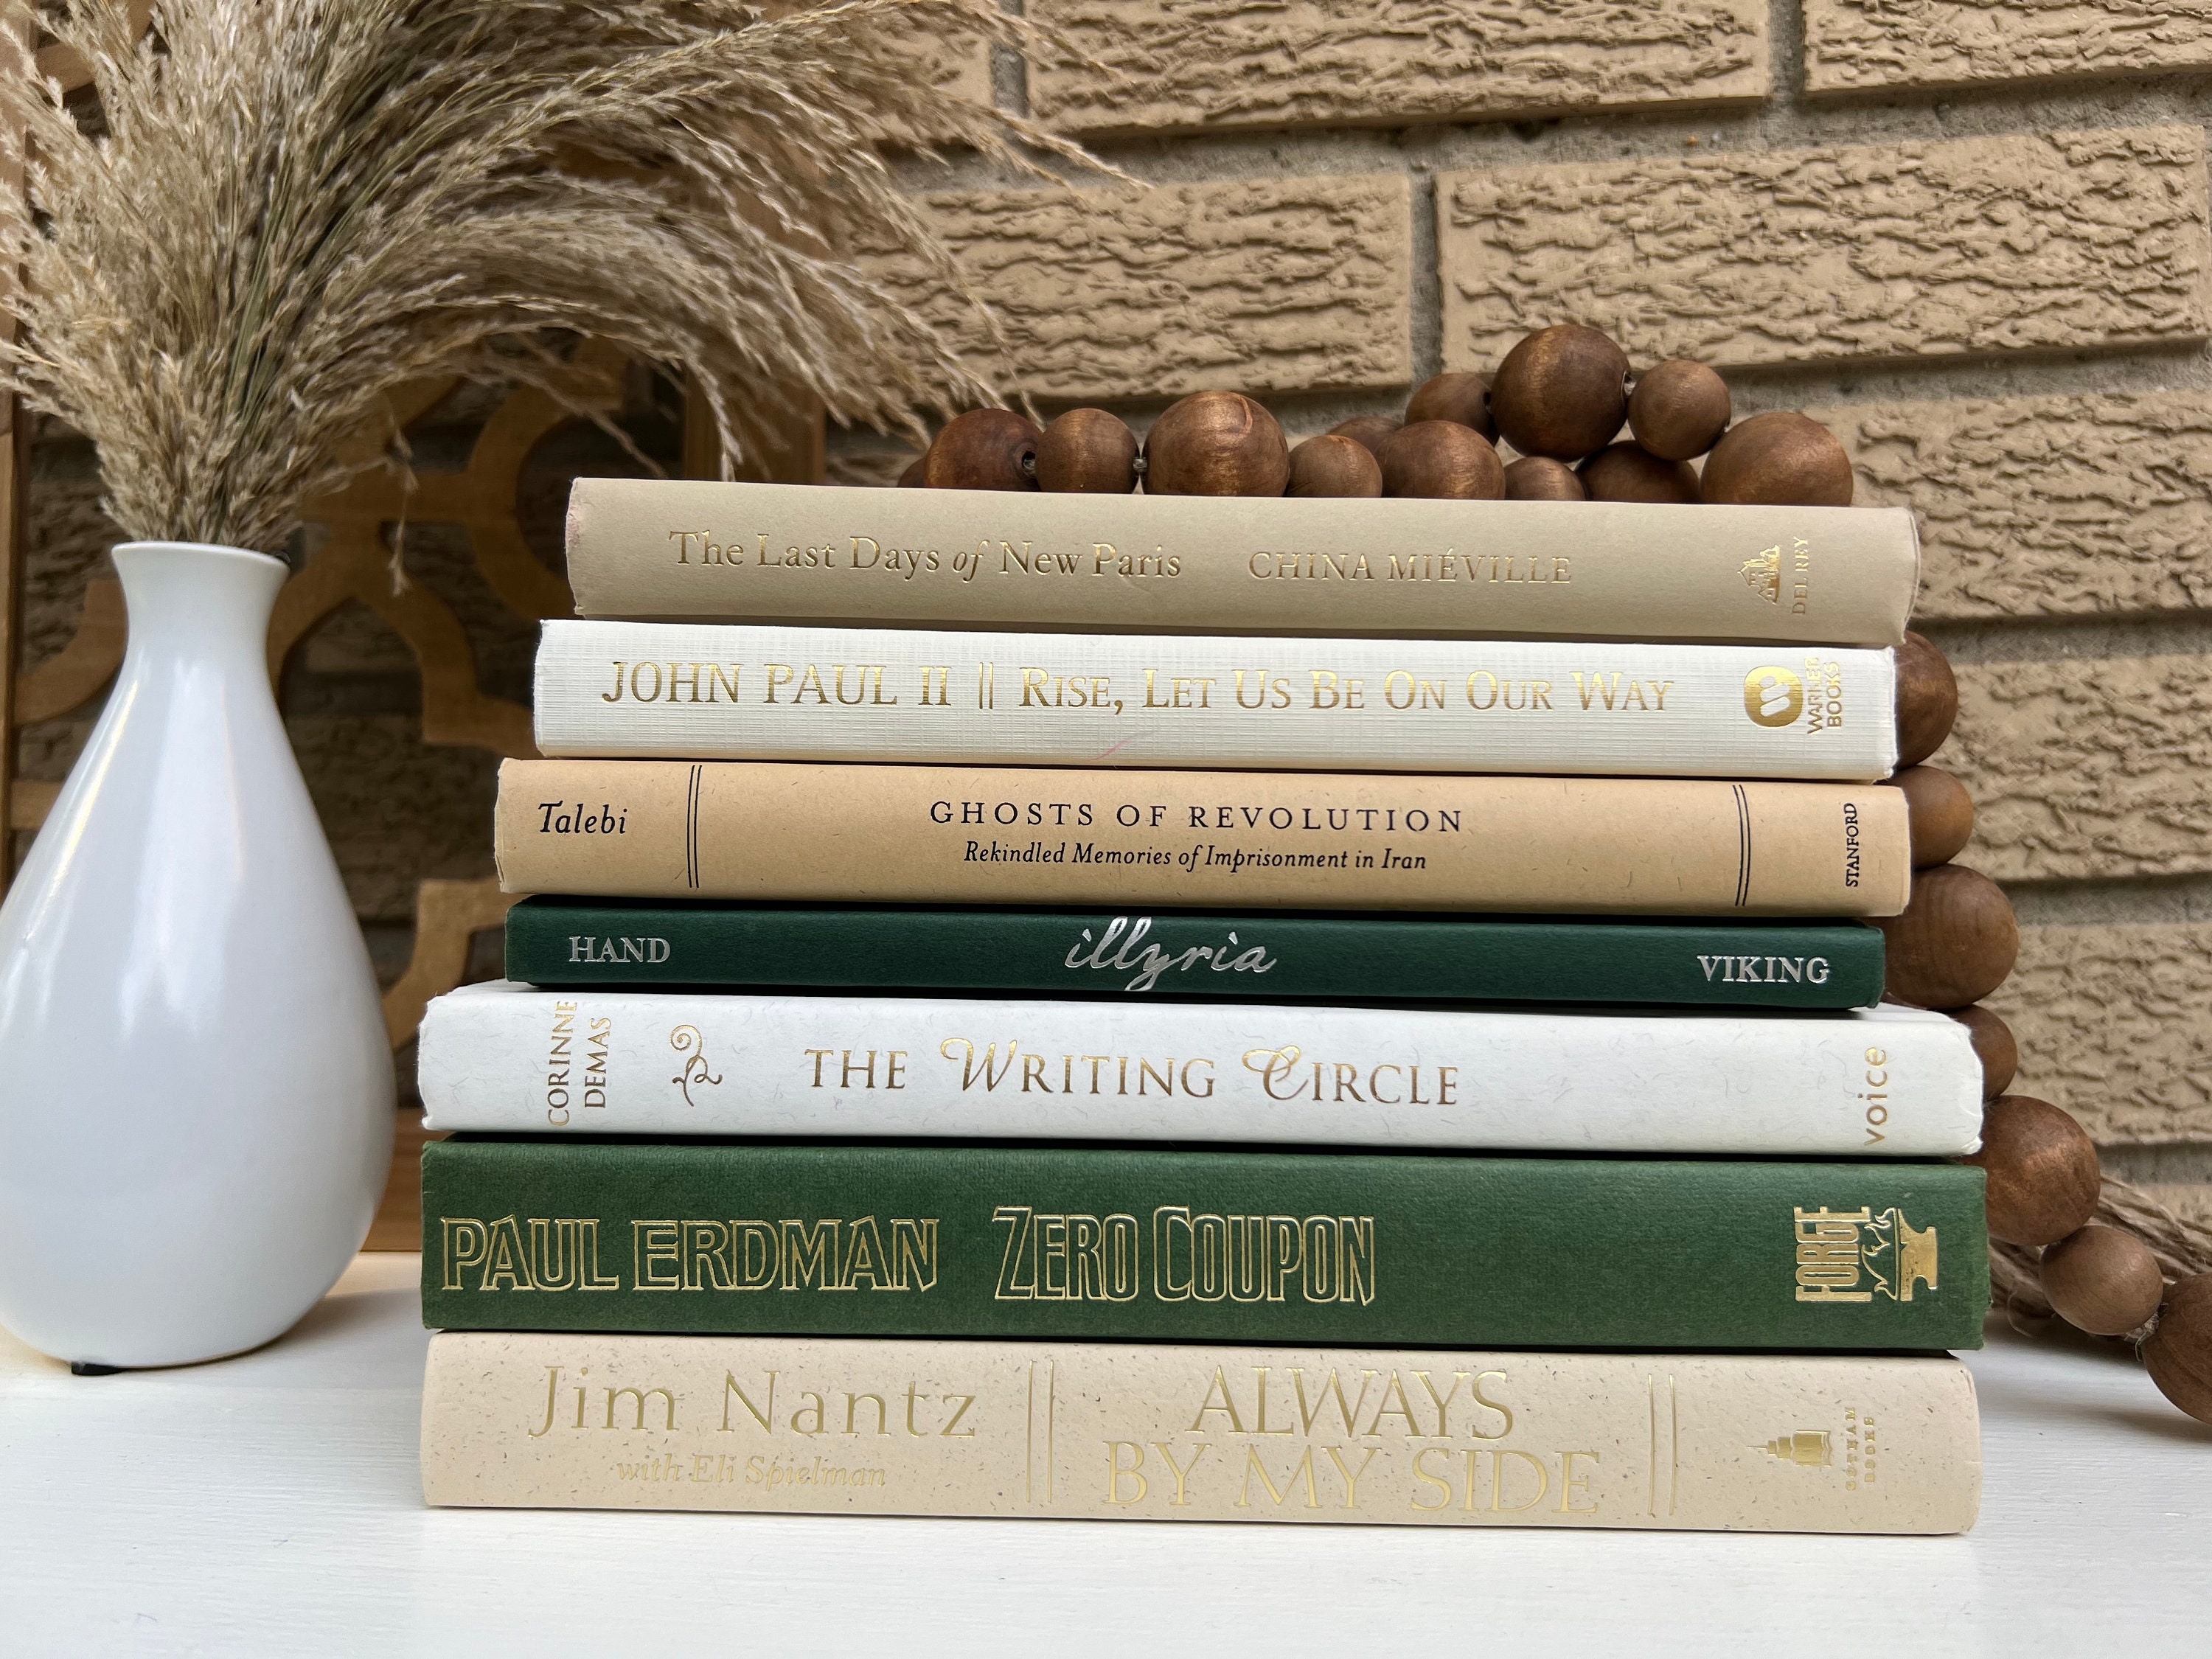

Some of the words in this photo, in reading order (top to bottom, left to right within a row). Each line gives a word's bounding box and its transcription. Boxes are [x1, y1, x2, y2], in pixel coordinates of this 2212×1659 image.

[669, 531, 744, 566] The
[757, 534, 835, 569] Last
[850, 536, 939, 581] Days
[953, 540, 990, 583] of
[999, 541, 1082, 576] New
[1092, 543, 1181, 579] Paris
[1248, 551, 1373, 582] CHINA
[1388, 547, 1572, 585] MIÉVILLE
[1793, 536, 1810, 572] REY
[1792, 577, 1809, 616] DEL
[603, 662, 743, 704] JOHN
[764, 664, 898, 706] PAUL
[918, 666, 952, 707] II
[1804, 656, 1824, 735] WARNER
[1823, 661, 1843, 728] BOOKS
[538, 800, 628, 835] Talebi
[931, 801, 1093, 827] GHOSTS
[1117, 804, 1166, 827] OF
[1189, 807, 1462, 833] REVOLUTION
[1844, 803, 1860, 888] STANFORD
[964, 841, 1065, 865] Rekindled
[1072, 844, 1171, 867] Memories
[1178, 846, 1203, 872] of
[1205, 846, 1350, 873] Imprisonment
[1355, 849, 1374, 869] in
[1382, 849, 1427, 870] Iran
[568, 936, 672, 964] HAND
[1065, 915, 1279, 992] illyria
[1697, 955, 1831, 984] VIKING
[547, 1001, 577, 1127] CORINNE
[584, 1017, 612, 1109] DEMAS
[804, 1048, 908, 1090] THE
[1857, 1047, 1888, 1146] voice
[440, 1214, 620, 1291] PAUL
[631, 1214, 939, 1293] ERDMAN
[1793, 1206, 1873, 1302] FORGE
[528, 1366, 685, 1438] Jim
[716, 1368, 977, 1438] Nantz
[1184, 1364, 1514, 1441] ALWAYS
[616, 1453, 683, 1483] with
[689, 1453, 734, 1484] Eli
[745, 1455, 887, 1493] Spielman
[1102, 1440, 1213, 1506] BY
[1234, 1443, 1382, 1509] MY
[1409, 1447, 1601, 1514] SIDE
